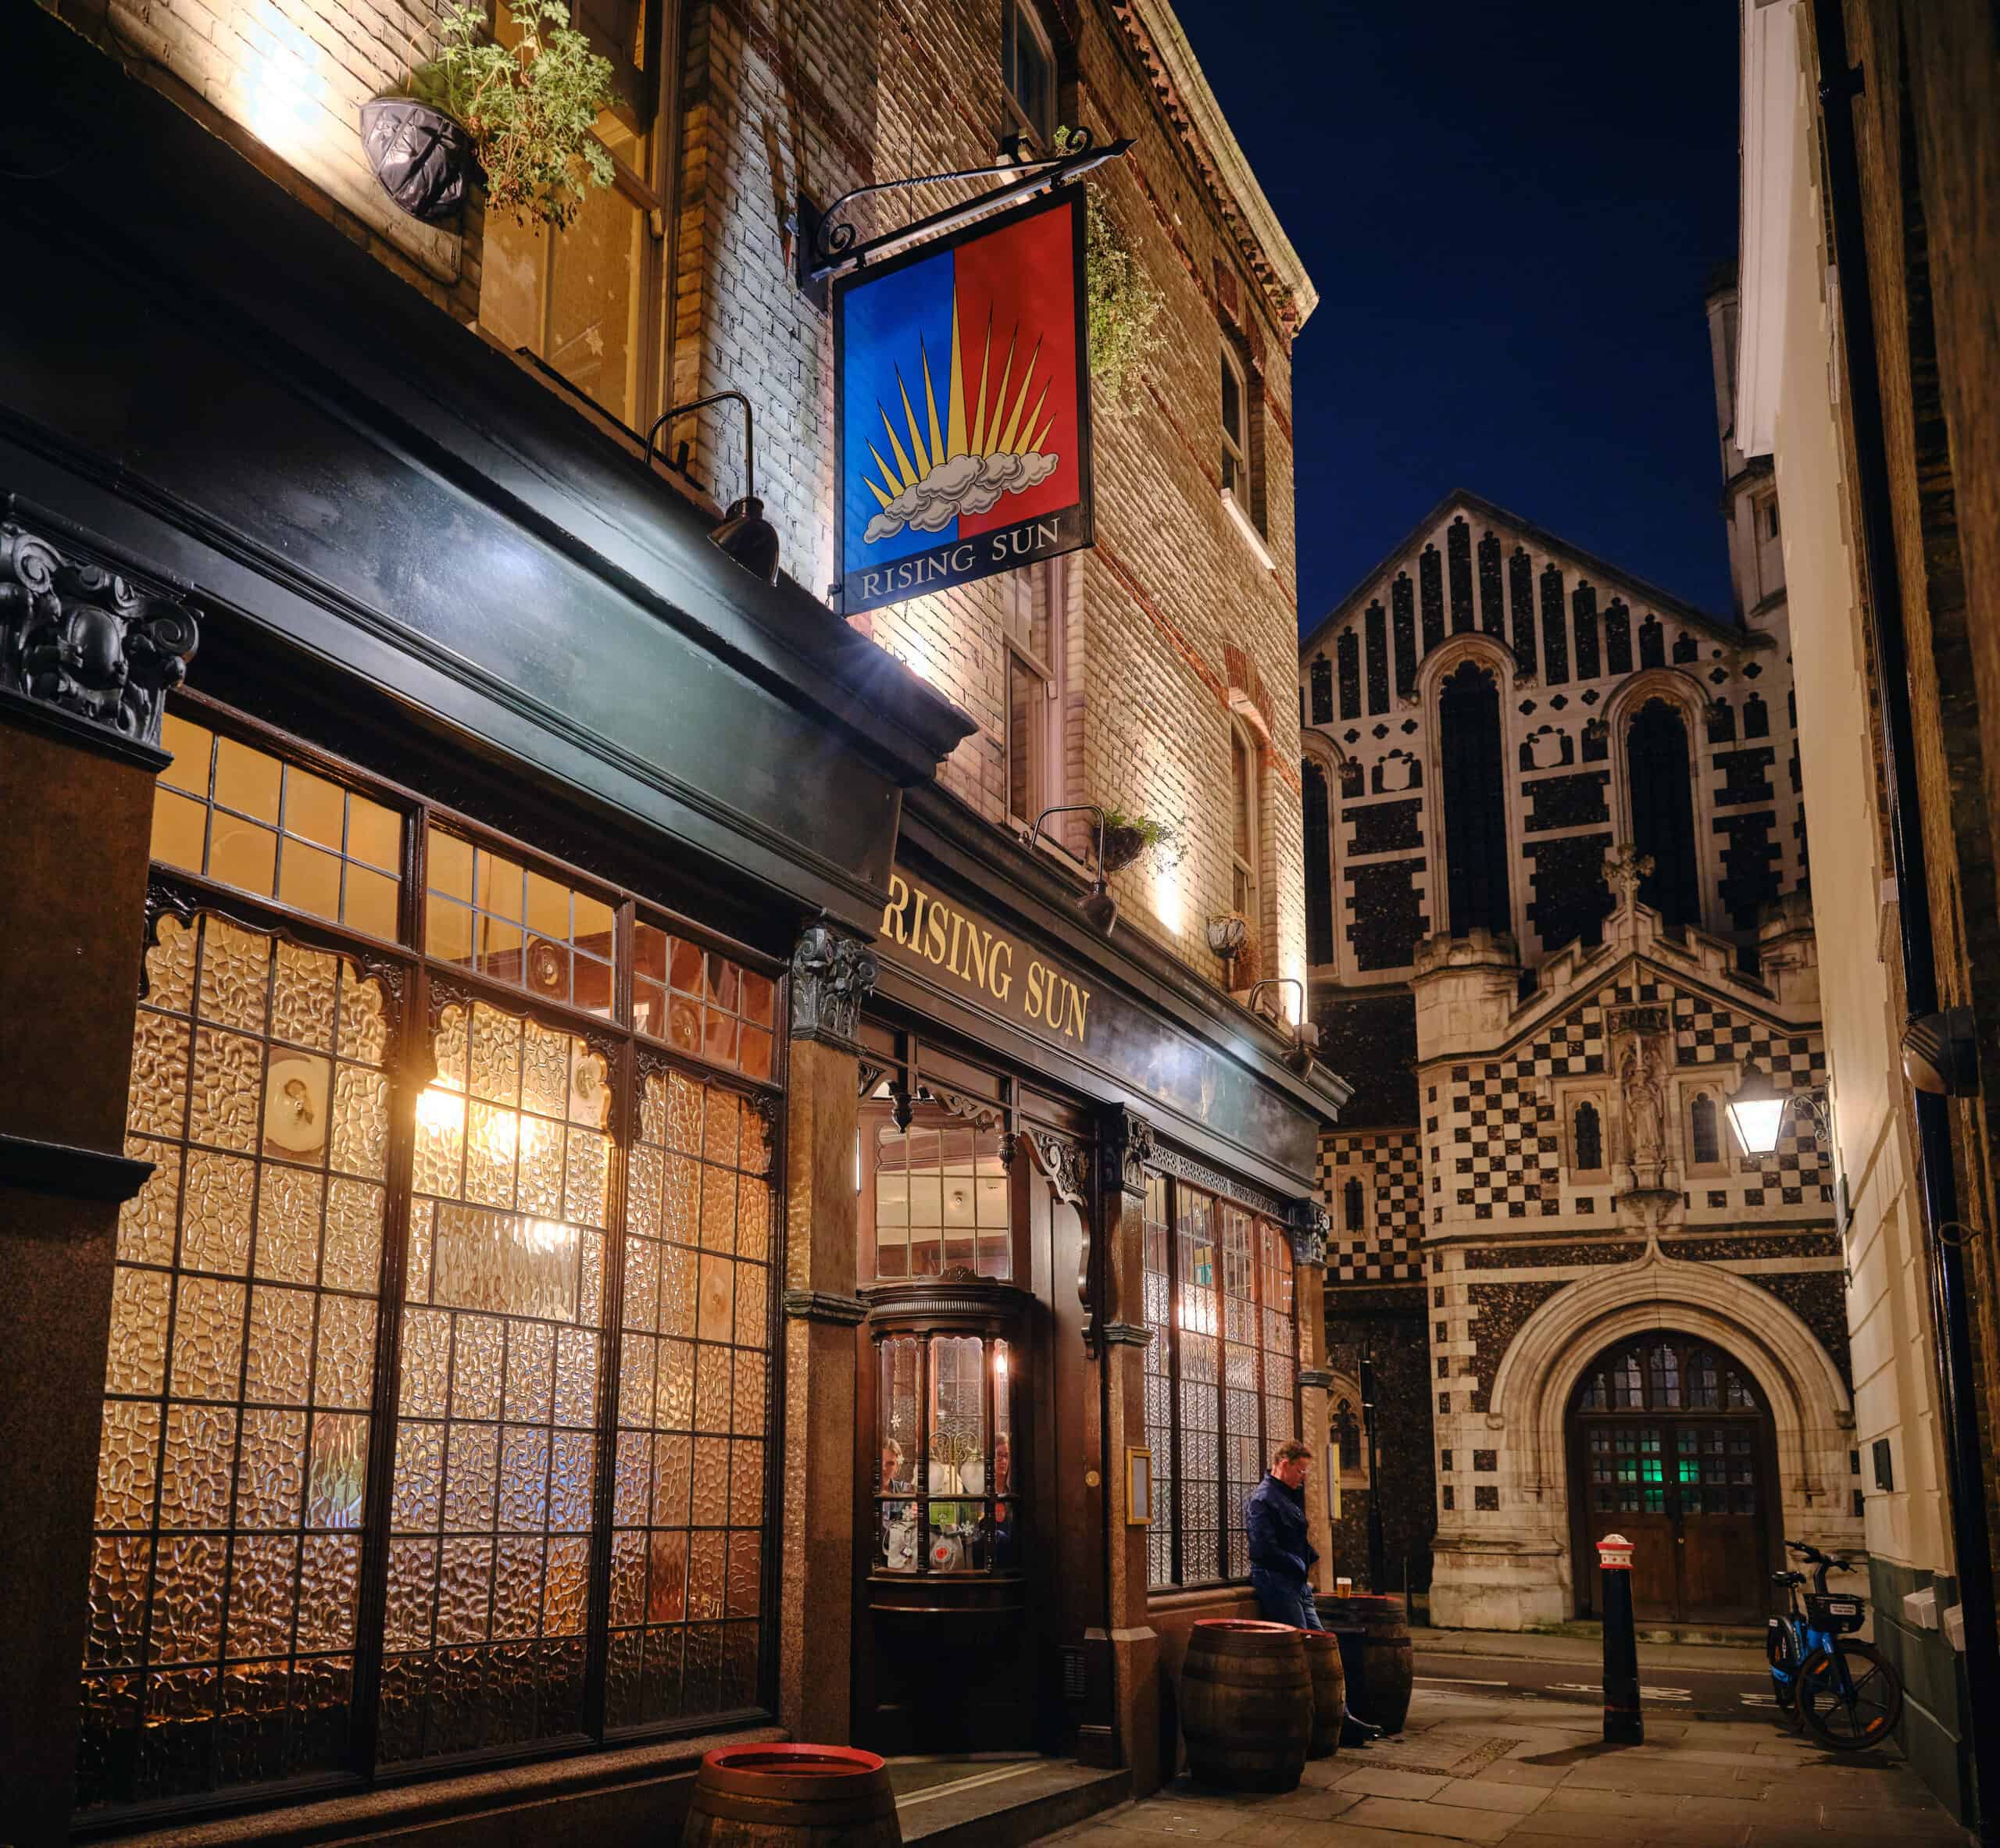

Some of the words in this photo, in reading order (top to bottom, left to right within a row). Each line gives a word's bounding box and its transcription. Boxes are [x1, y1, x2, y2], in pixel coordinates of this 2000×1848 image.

[861, 544, 975, 600] RISING
[991, 517, 1060, 561] SUN
[880, 874, 1012, 1002] RISING
[1024, 961, 1090, 1042] SUN
